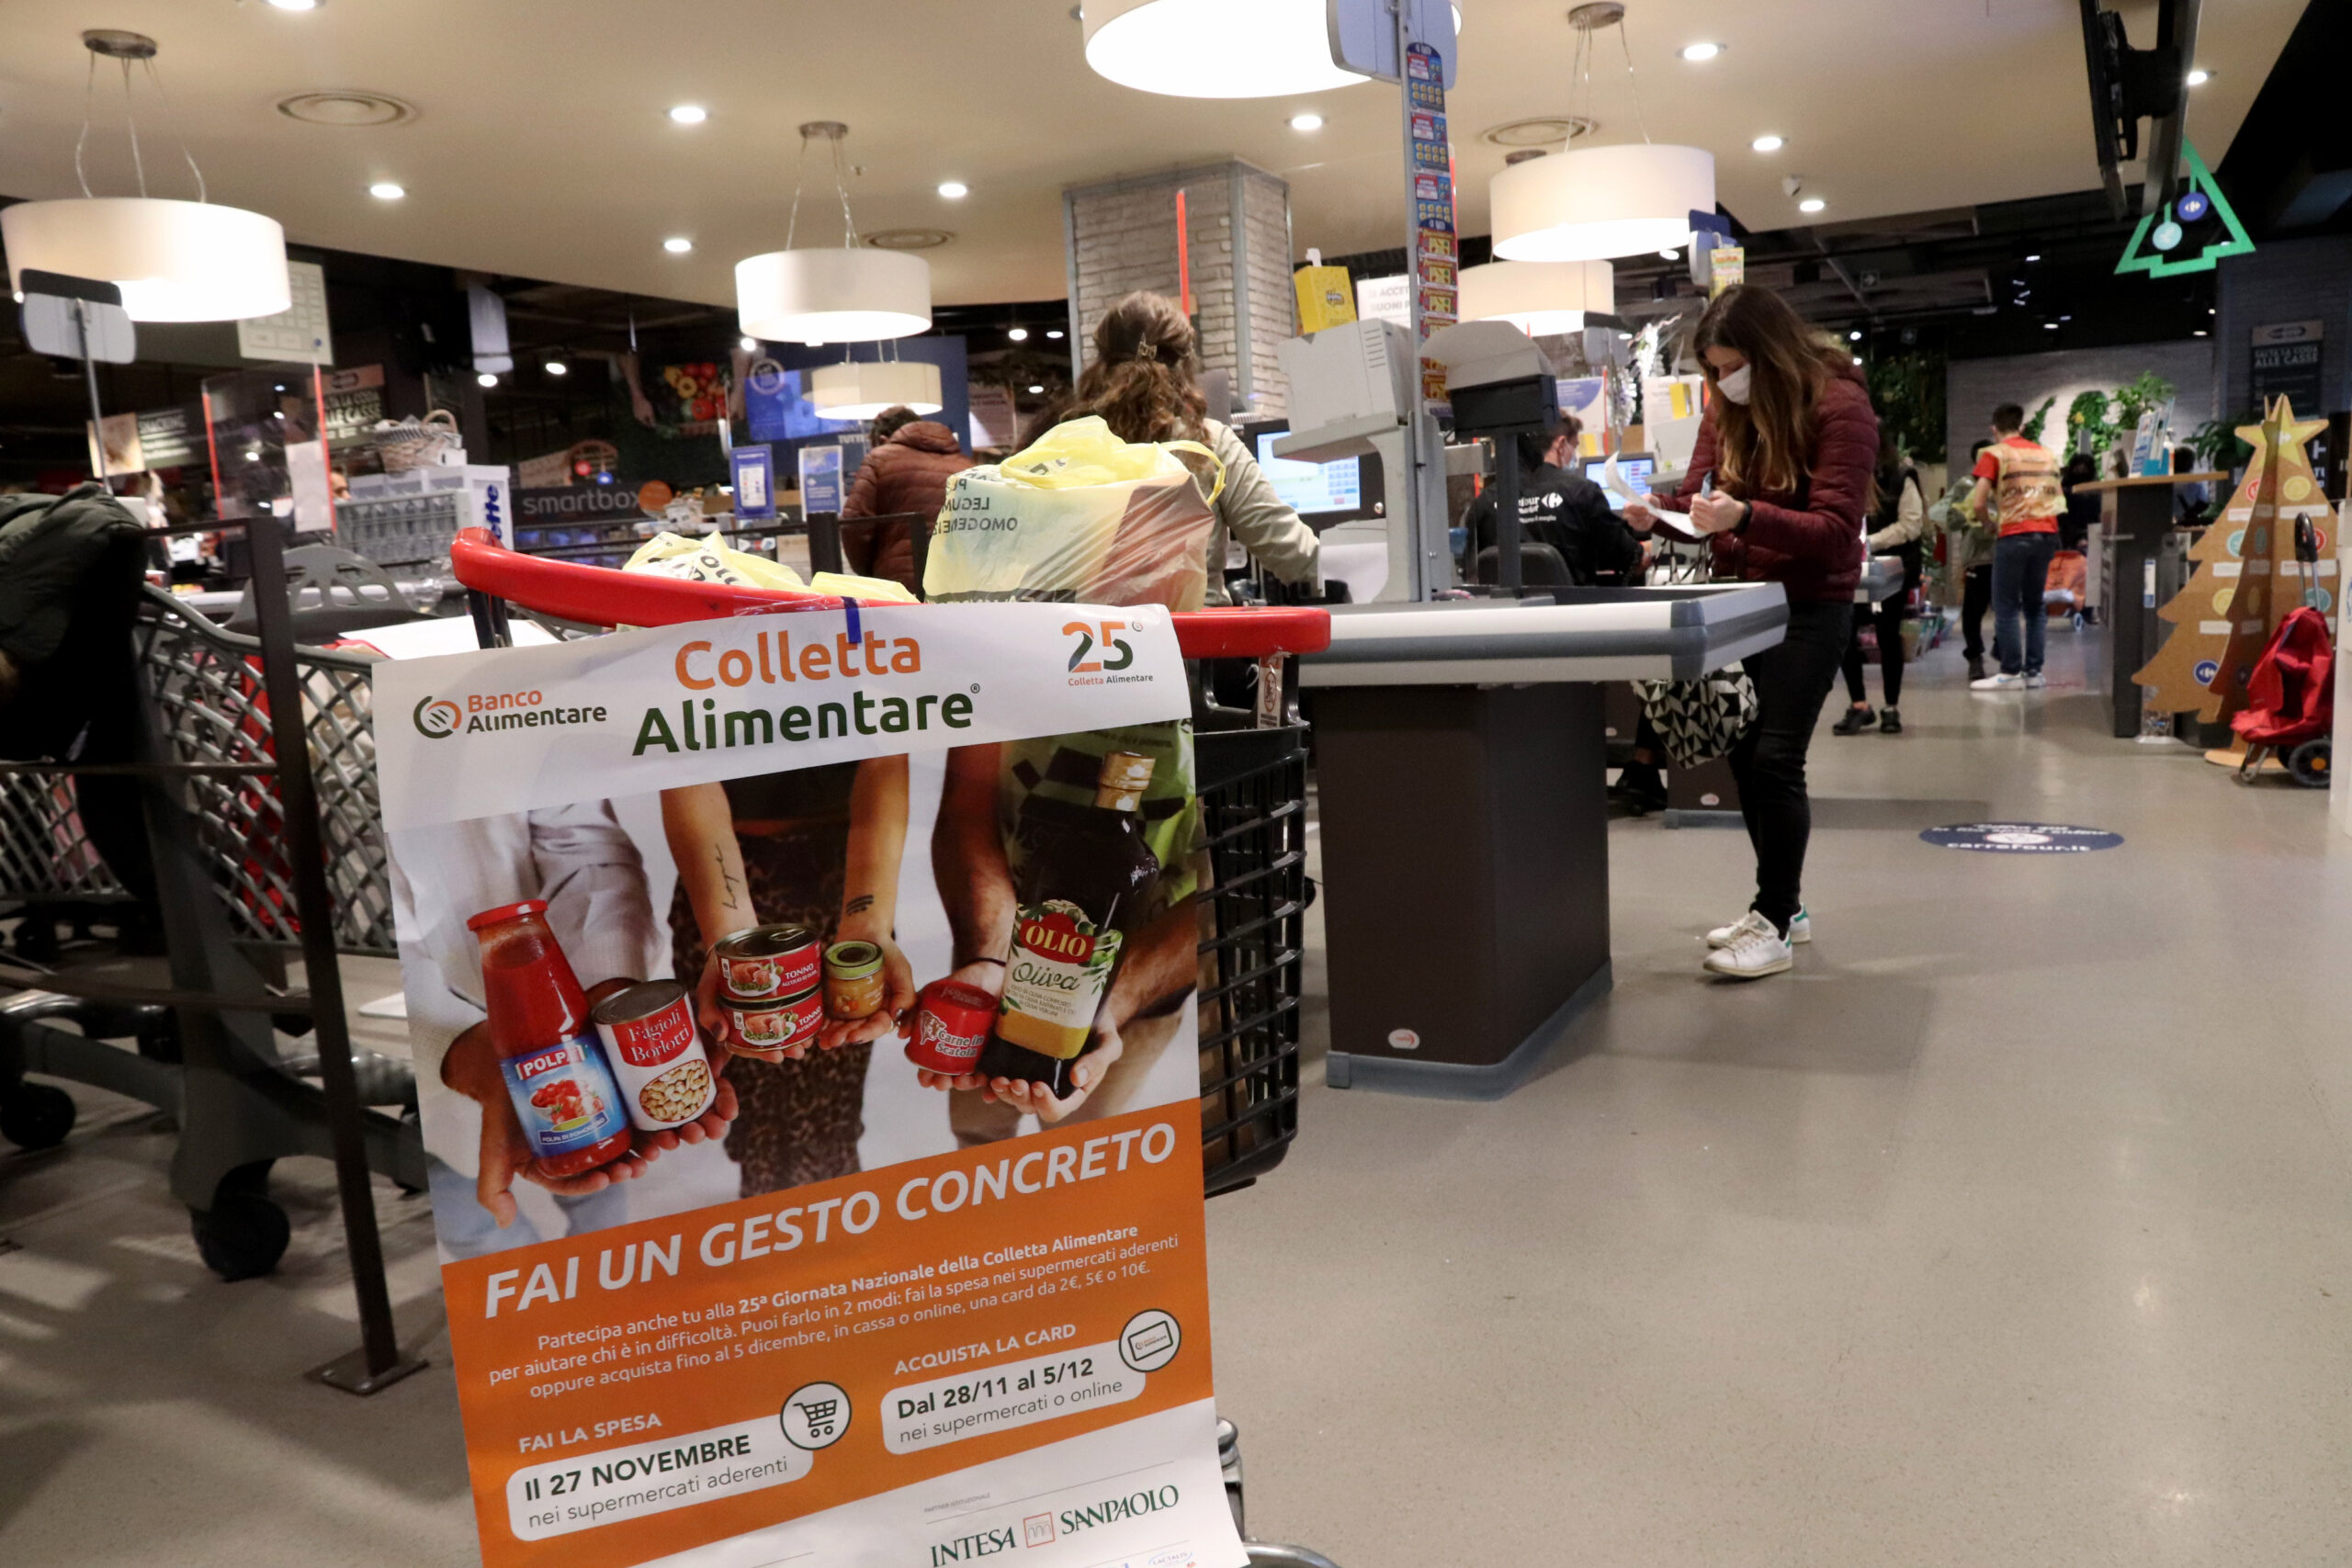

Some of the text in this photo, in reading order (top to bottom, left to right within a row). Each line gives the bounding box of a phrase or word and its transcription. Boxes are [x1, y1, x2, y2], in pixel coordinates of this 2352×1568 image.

[675, 630, 922, 691] Colletta
[1068, 674, 1154, 686] Colletta Alimentare
[466, 705, 607, 734] Alimentare
[468, 690, 543, 713] Banco
[1025, 926, 1087, 957] OLIO
[785, 963, 814, 979] TONNO
[1012, 962, 1080, 991] Oliva
[628, 1009, 682, 1043] Fagioli
[798, 1006, 821, 1026] TONNO
[629, 1024, 691, 1062] Borlotti
[935, 1043, 978, 1057] Scatola
[937, 1030, 970, 1046] Carne
[485, 1122, 1176, 1319] FAI UN GESTO CONCRETO
[537, 1325, 622, 1350] Partecipa
[627, 1314, 678, 1335] anche
[682, 1310, 701, 1325] tu
[706, 1302, 735, 1321] alla
[772, 1283, 847, 1308] Giornata
[851, 1264, 934, 1293] Nazionale
[938, 1256, 979, 1275] della
[983, 1243, 1047, 1266] Colletta
[1051, 1226, 1138, 1253] Alimentare
[490, 1234, 1180, 1386] per aiutare chi è in difficoltà. Puoi farlo in 2 modi: fai la spesa nei supermercati aderenti
[530, 1261, 1150, 1399] oppure acquista fino al 5 dicembre, in cassa o online, una card da 2€, 5€ o 10€.
[893, 1324, 1077, 1376] ACQUISTA LA CARD
[897, 1358, 1094, 1419] Dal 28/11 al 5/12
[899, 1380, 1123, 1443] nei supermercati o online
[519, 1412, 662, 1453] FAI LA SPESA
[525, 1434, 752, 1502] Il 27 NOVEMBRE
[528, 1456, 788, 1529] nei supermercati aderenti
[931, 1484, 1180, 1568] INTESA SANPAOLO
